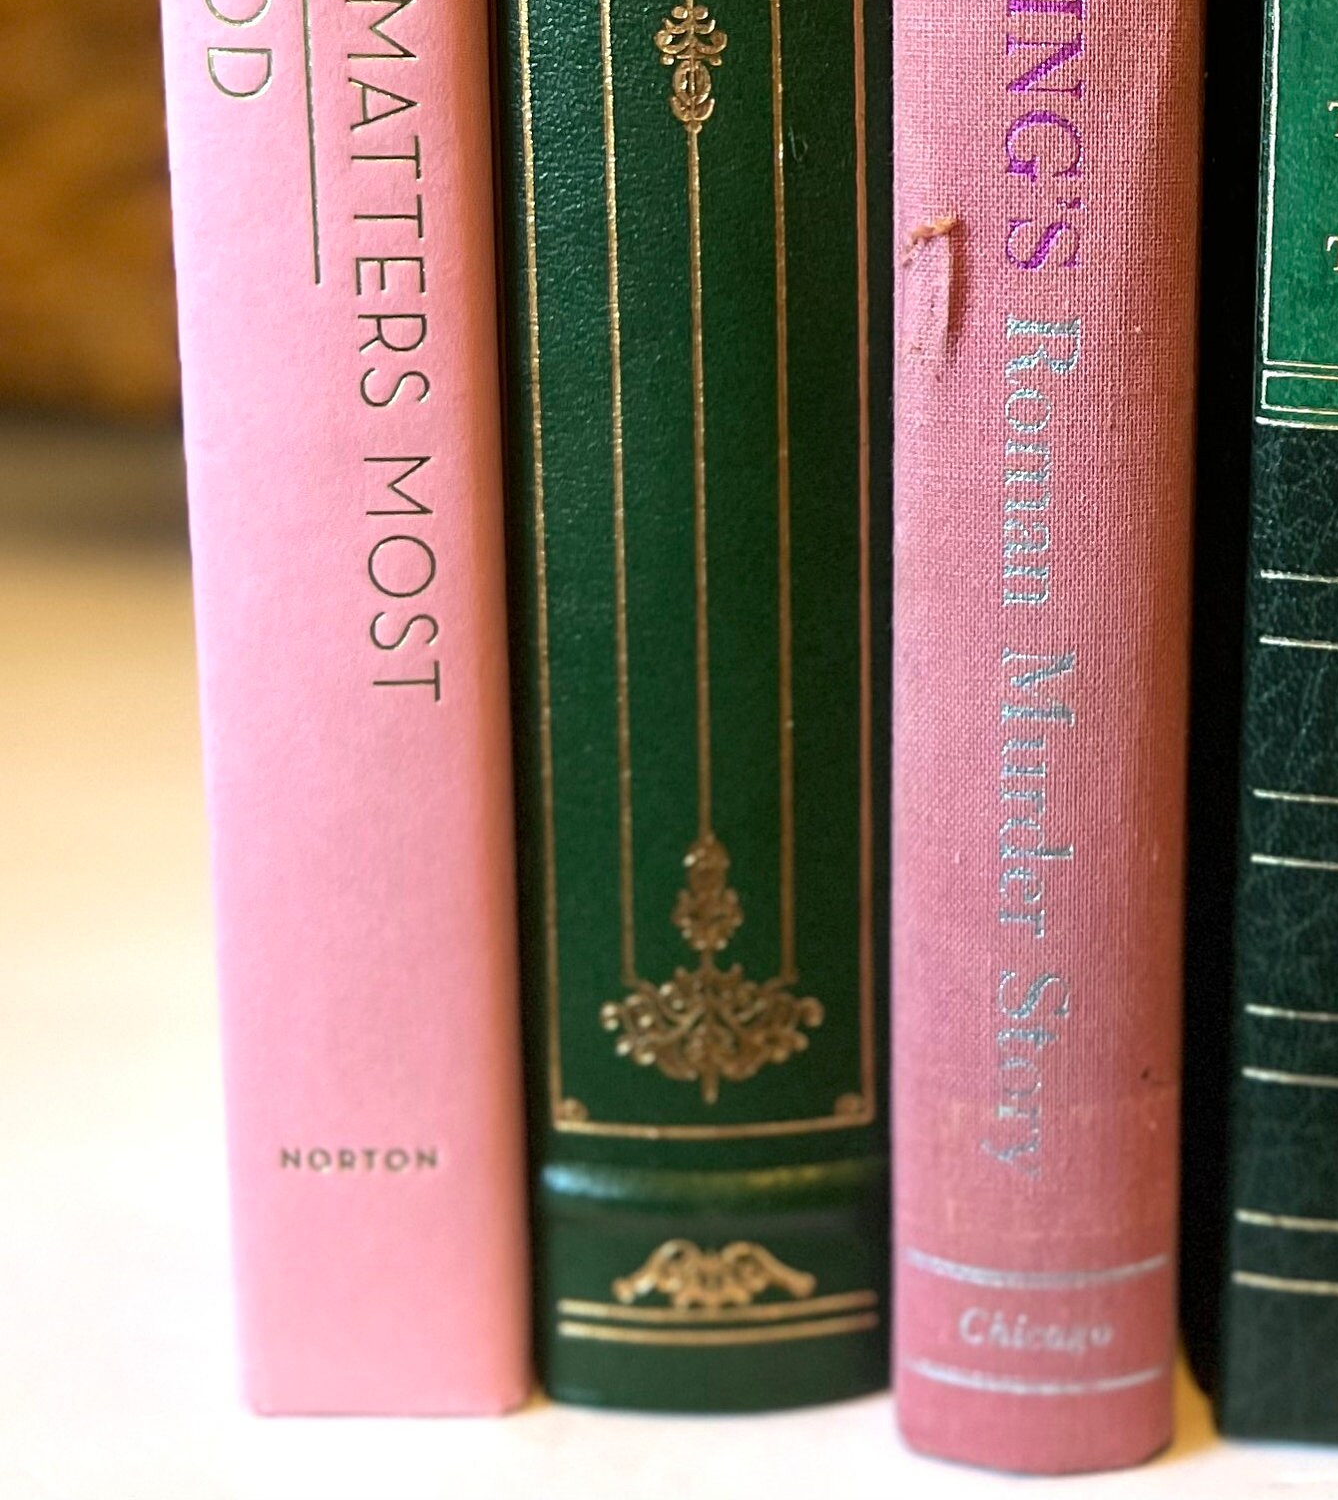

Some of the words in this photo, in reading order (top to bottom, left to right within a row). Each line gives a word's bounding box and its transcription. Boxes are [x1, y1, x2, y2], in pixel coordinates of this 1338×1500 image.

[1001, 312, 1083, 607] Roman
[361, 453, 442, 704] MOST
[998, 647, 1078, 940] Murder
[279, 1147, 440, 1173] NORTON
[983, 968, 1070, 1182] Story
[958, 1306, 1114, 1357] Chicago
